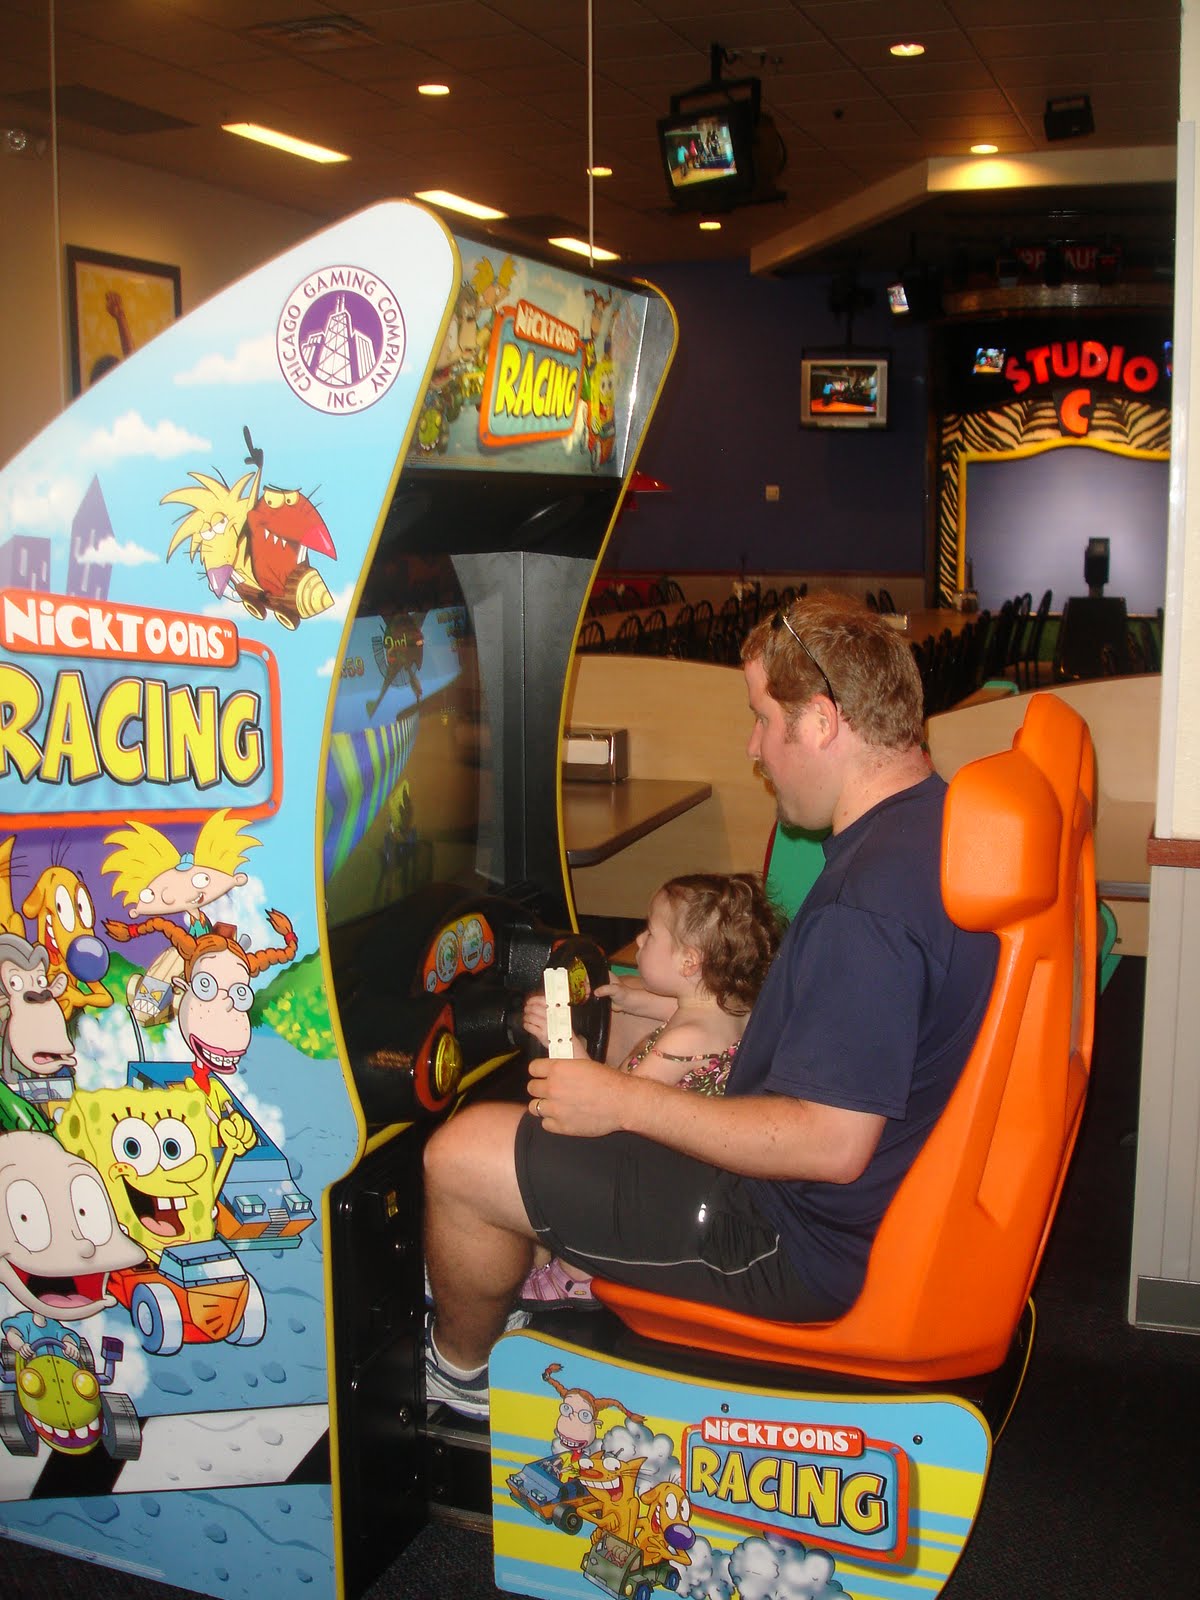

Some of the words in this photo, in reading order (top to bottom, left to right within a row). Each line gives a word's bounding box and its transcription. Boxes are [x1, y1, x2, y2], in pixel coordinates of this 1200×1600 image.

[282, 304, 312, 393] CHICAGO
[303, 270, 378, 299] GAMING
[370, 296, 401, 394] COMPANY
[1005, 340, 1159, 394] STUDIO
[326, 391, 364, 409] INC.
[494, 343, 579, 419] RACING
[1060, 388, 1092, 435] C
[0, 661, 265, 791] RACING
[690, 1445, 889, 1536] RACING
